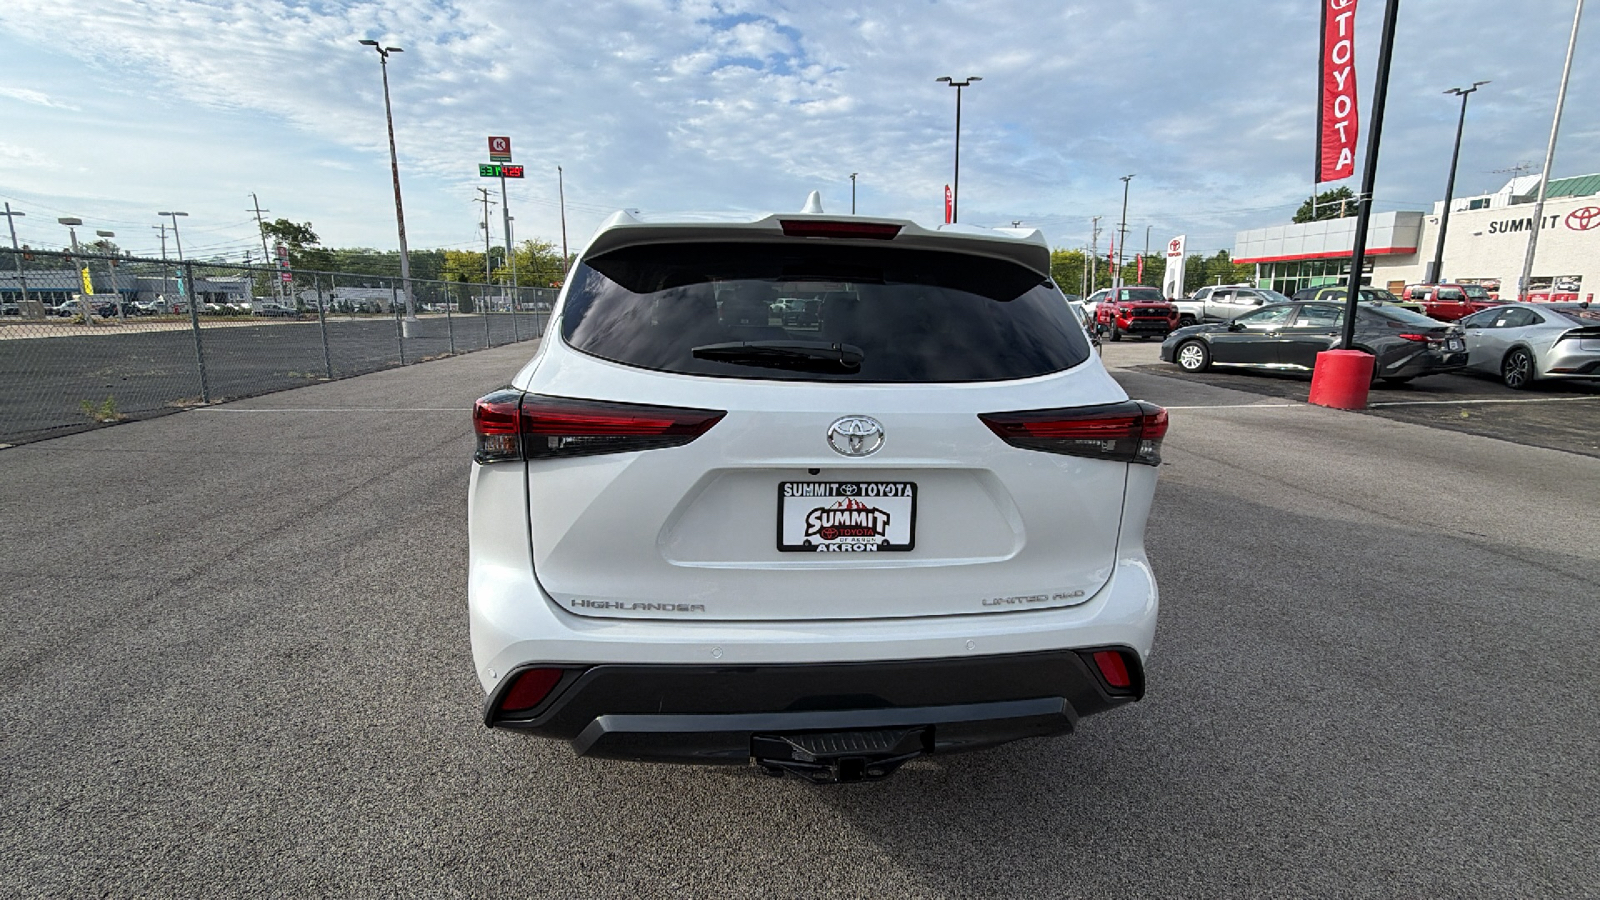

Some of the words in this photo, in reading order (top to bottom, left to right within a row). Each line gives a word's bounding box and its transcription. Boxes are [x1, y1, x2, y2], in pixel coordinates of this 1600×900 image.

[1332, 11, 1352, 171] TOYOTA
[1488, 215, 1560, 234] SUMMIT
[784, 483, 838, 496] SUMMIT
[860, 483, 912, 496] TOYOTA
[807, 508, 888, 535] SUMMIT
[840, 528, 874, 536] TOYOTA
[816, 543, 877, 552] AKRON
[571, 600, 705, 612] HIGHLANDER
[982, 595, 1048, 605] LIMITED
